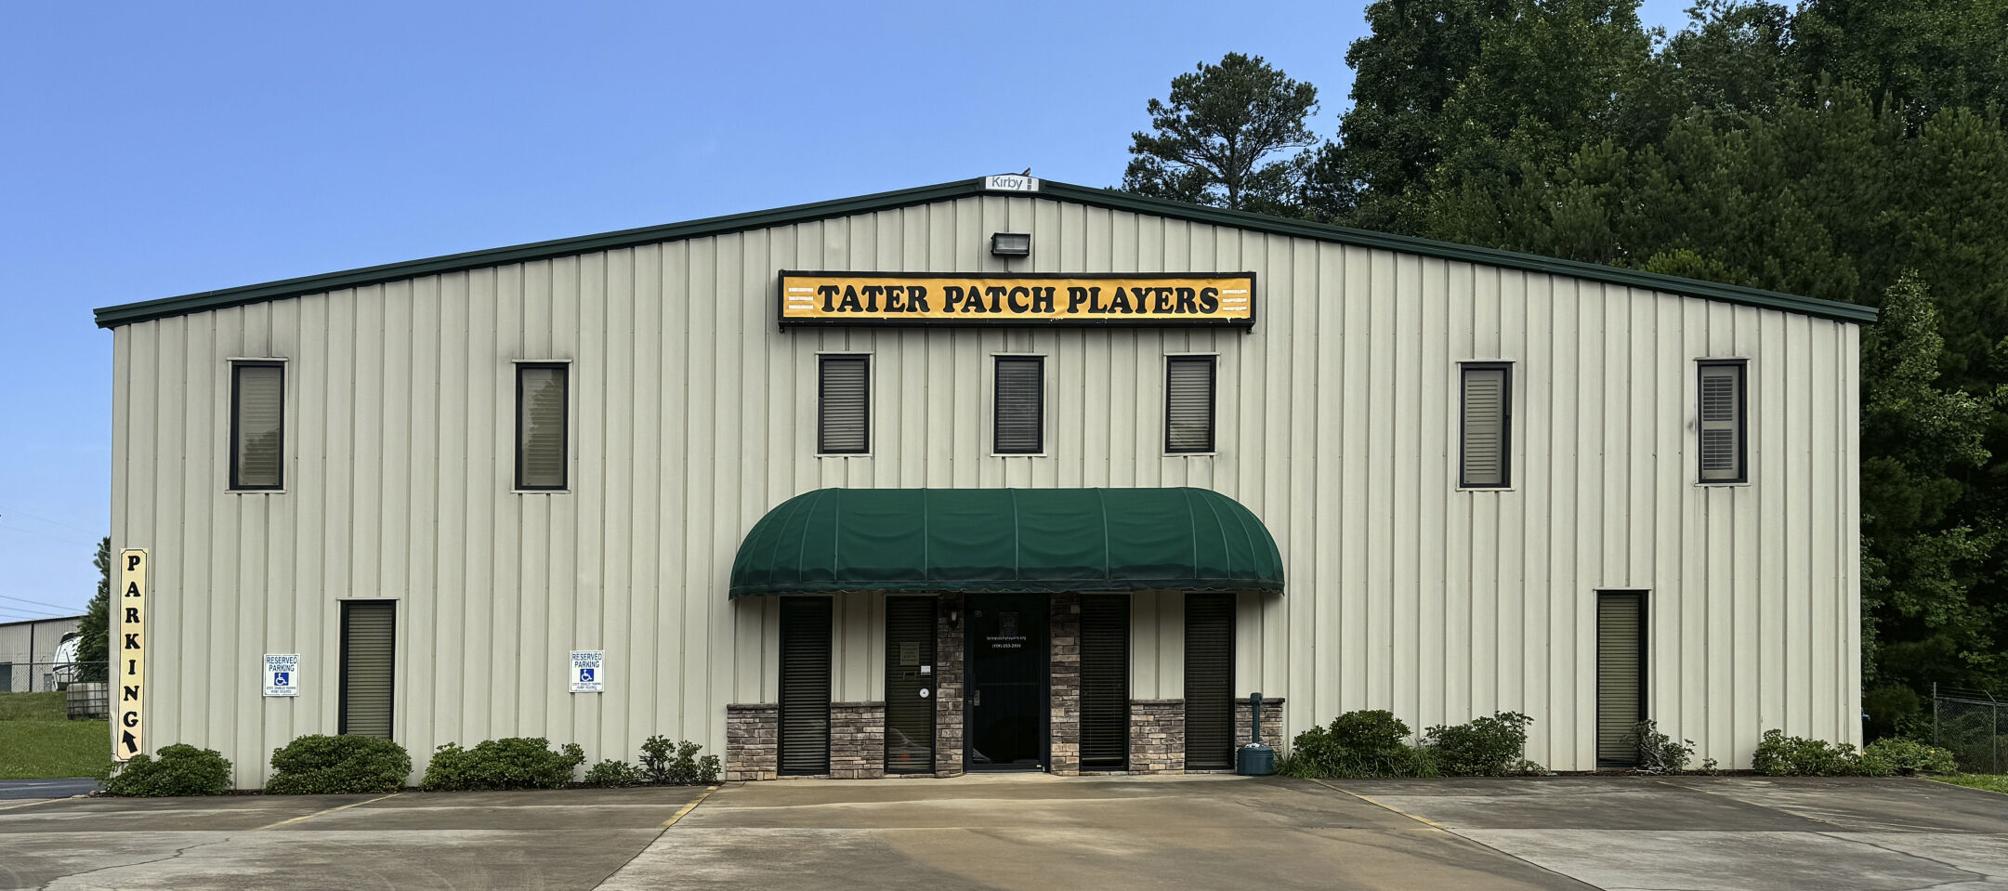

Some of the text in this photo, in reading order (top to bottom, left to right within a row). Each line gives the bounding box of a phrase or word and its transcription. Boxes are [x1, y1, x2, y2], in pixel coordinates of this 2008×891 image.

[992, 176, 1023, 190] Kirby
[817, 285, 1219, 313] TATER PATCH PLAYERS
[123, 555, 141, 727] PARKING
[266, 656, 298, 664] RESERVED
[574, 660, 600, 668] PARKING
[268, 664, 295, 672] PARKING
